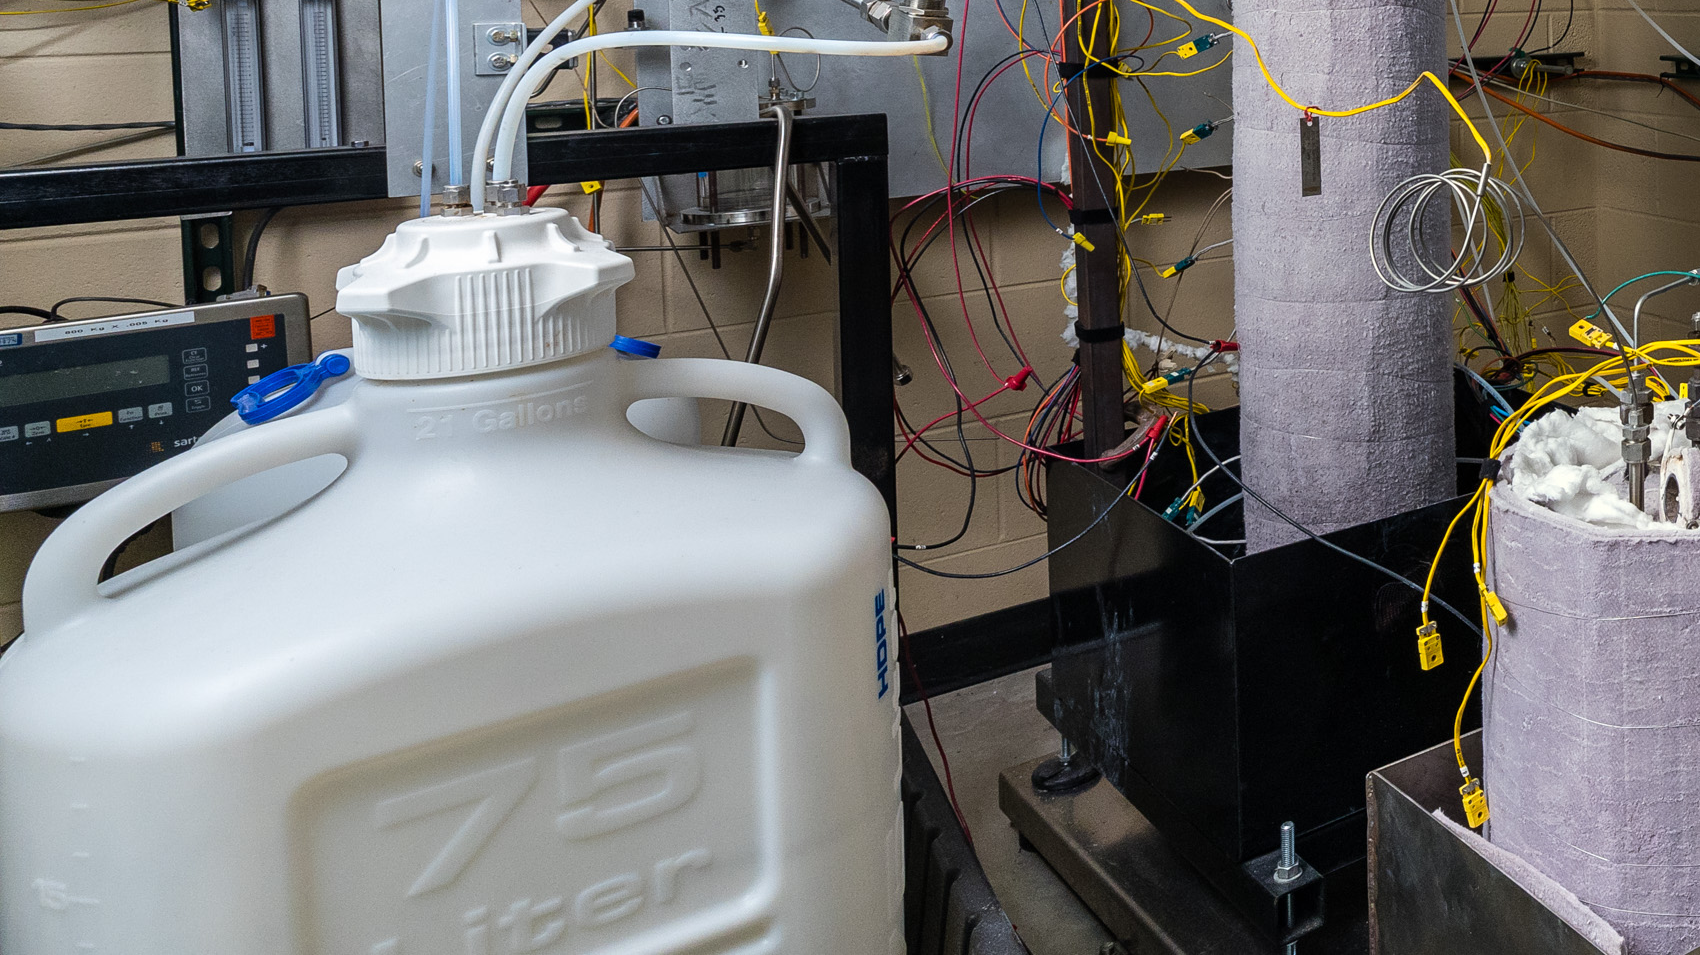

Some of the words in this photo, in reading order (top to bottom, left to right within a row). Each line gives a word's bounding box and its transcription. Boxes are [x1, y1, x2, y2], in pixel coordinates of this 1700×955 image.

[191, 385, 203, 393] OK
[415, 415, 454, 441] 21
[472, 395, 589, 433] Gallons
[874, 588, 889, 699] HDPE
[373, 710, 700, 900] 75
